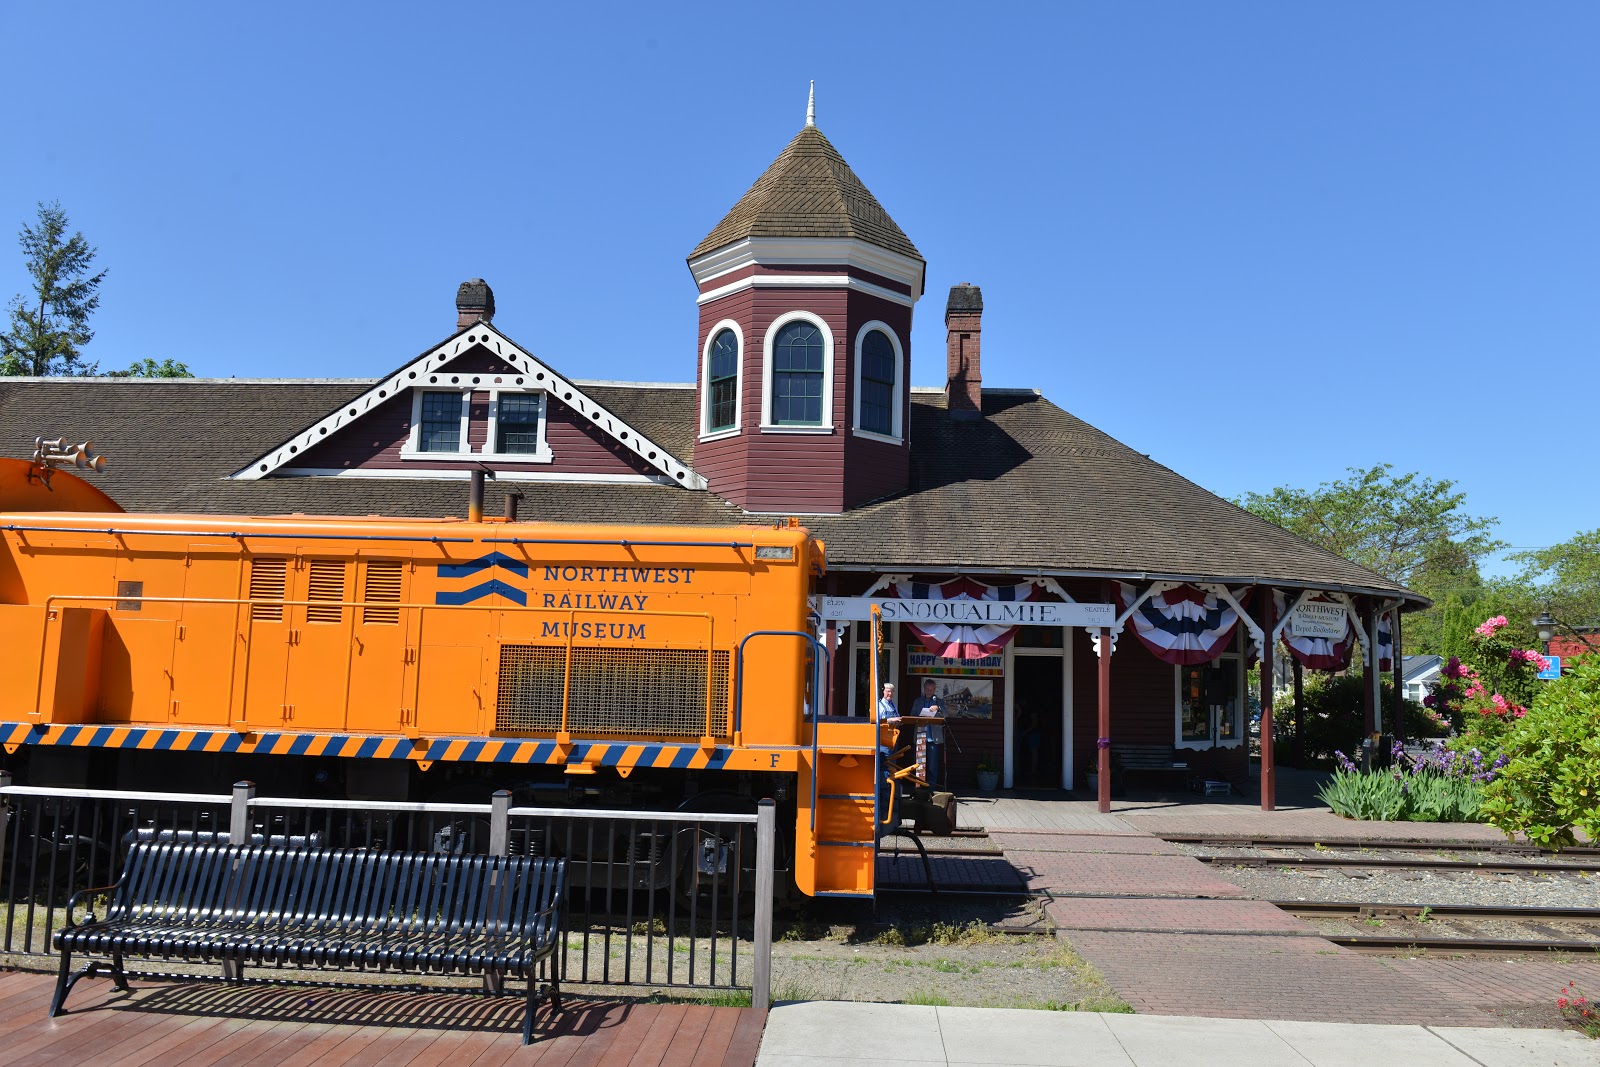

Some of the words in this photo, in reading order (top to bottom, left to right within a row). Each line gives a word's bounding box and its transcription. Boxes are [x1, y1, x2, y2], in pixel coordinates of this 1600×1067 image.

[543, 565, 696, 584] NORTHWEST
[543, 593, 649, 611] RAILWAY
[881, 601, 1057, 622] SNOQUALMIE
[541, 621, 647, 639] MUSEUM
[1295, 625, 1312, 633] Depot
[1313, 626, 1341, 634] Bookstore
[909, 654, 937, 666] HAPPY
[960, 656, 1002, 667] BIRTHDAY
[769, 753, 781, 768] F
